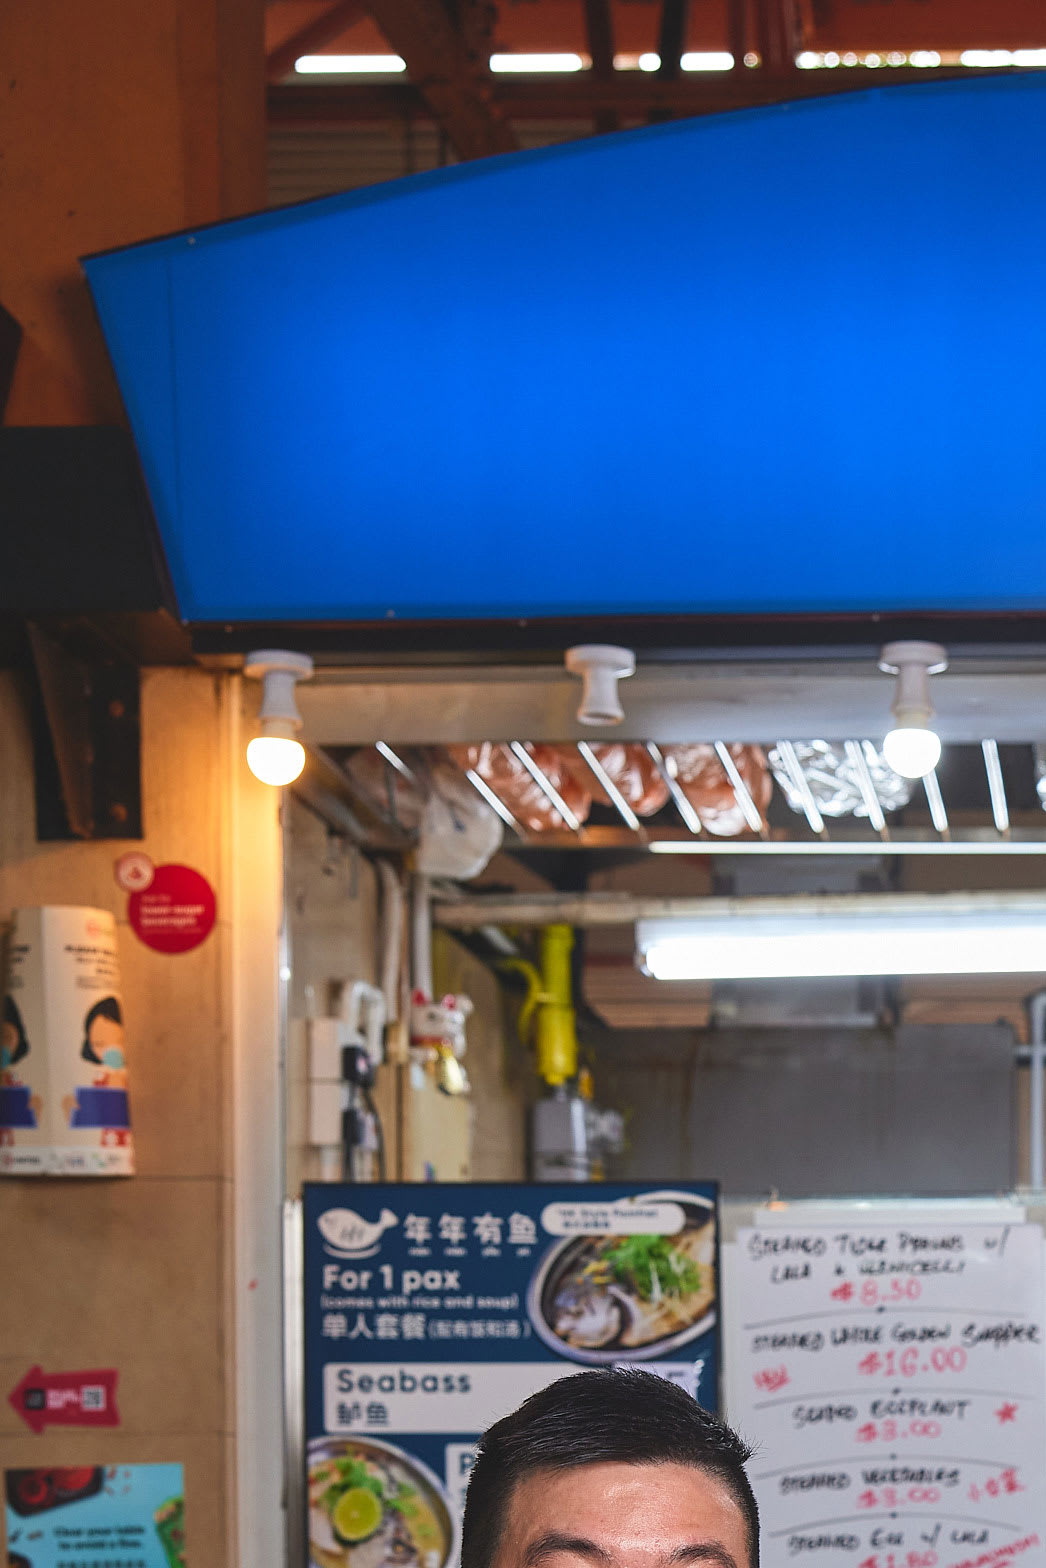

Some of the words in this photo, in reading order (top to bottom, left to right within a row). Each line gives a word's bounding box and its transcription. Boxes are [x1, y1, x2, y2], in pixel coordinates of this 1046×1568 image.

[403, 1212, 538, 1246] 年年有鱼
[322, 1264, 372, 1291] For
[379, 1264, 394, 1291] 1
[402, 1268, 461, 1295] pax
[336, 1368, 471, 1393] Seabass
